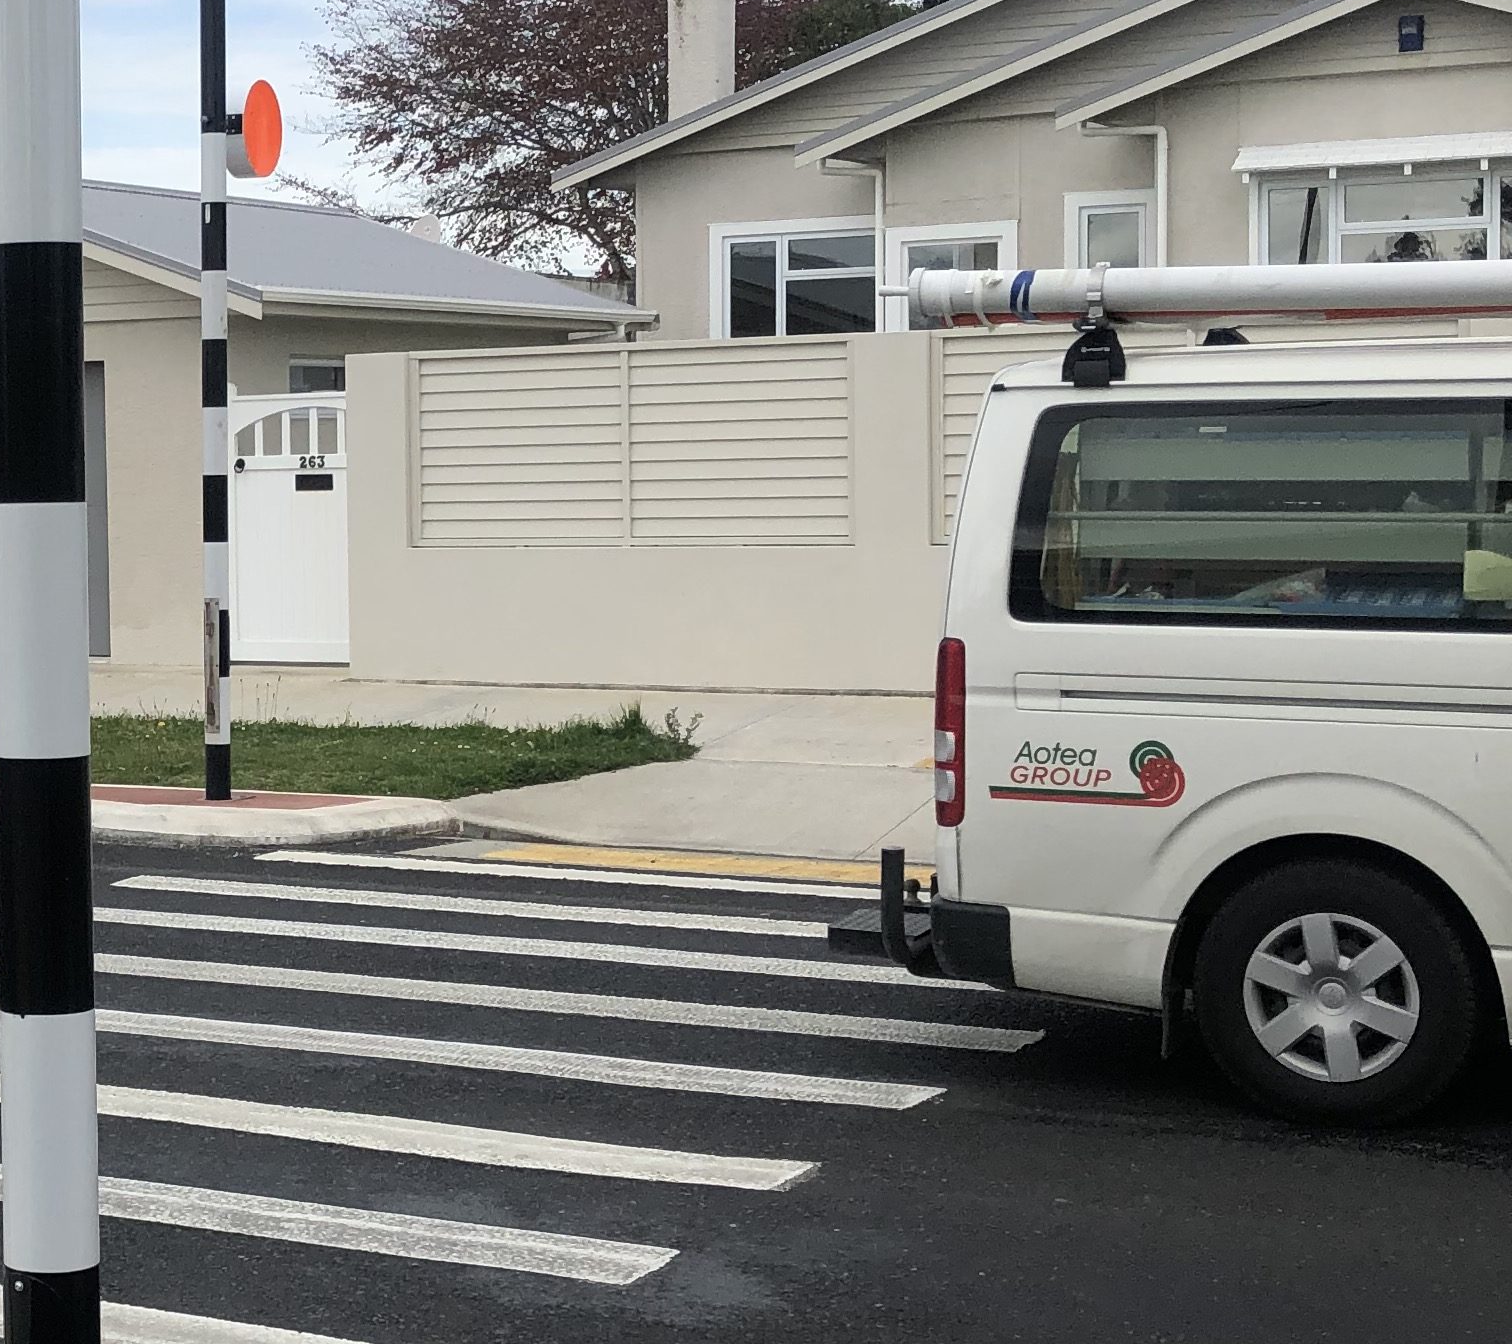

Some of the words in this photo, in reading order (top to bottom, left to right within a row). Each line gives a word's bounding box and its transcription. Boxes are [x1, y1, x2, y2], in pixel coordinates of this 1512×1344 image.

[299, 455, 326, 469] 263
[1013, 740, 1098, 767] Aotea
[1010, 765, 1112, 788] GROUP
